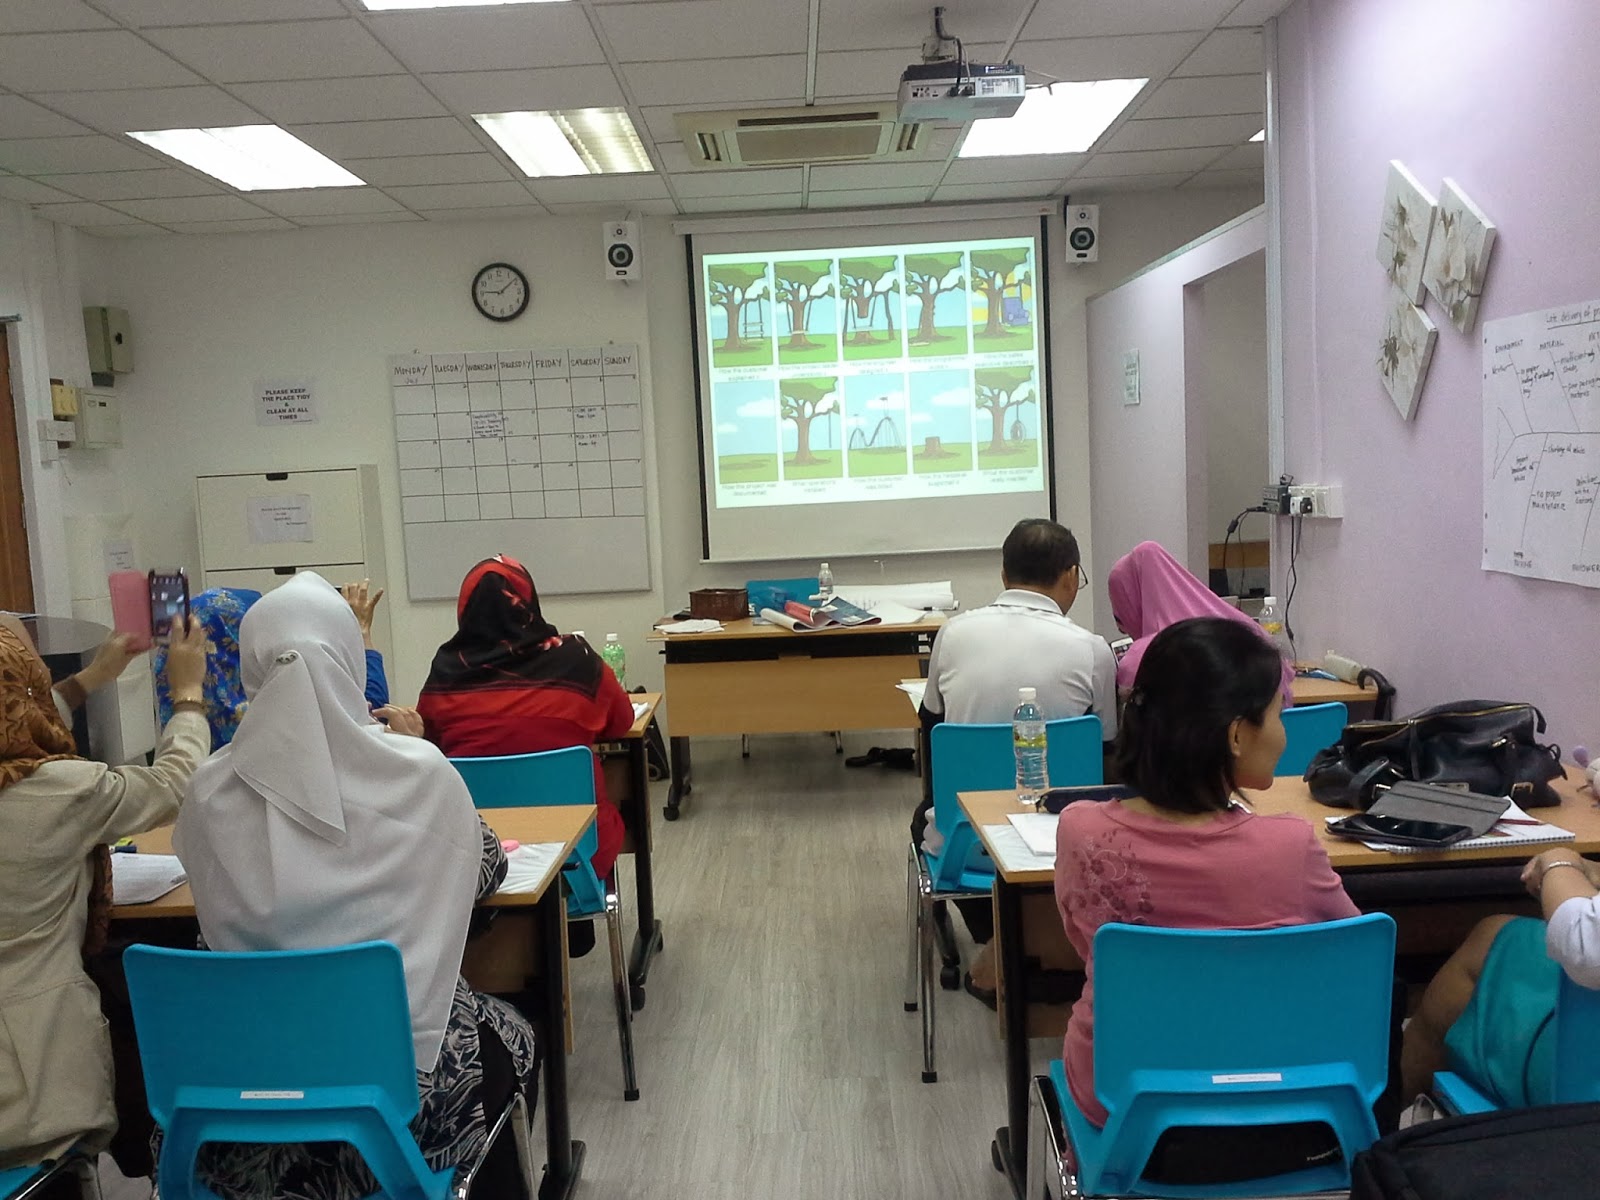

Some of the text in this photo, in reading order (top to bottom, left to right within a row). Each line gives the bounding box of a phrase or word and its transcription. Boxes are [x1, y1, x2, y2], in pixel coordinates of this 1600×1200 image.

[500, 360, 530, 369] THURSDAY
[535, 358, 562, 368] FRIDAY
[570, 358, 600, 368] SATURDAY
[604, 356, 630, 366] SUNDAY
[394, 364, 427, 376] MONDAY
[434, 364, 464, 374] TUESDAY
[467, 362, 496, 372] WEDNESDAY
